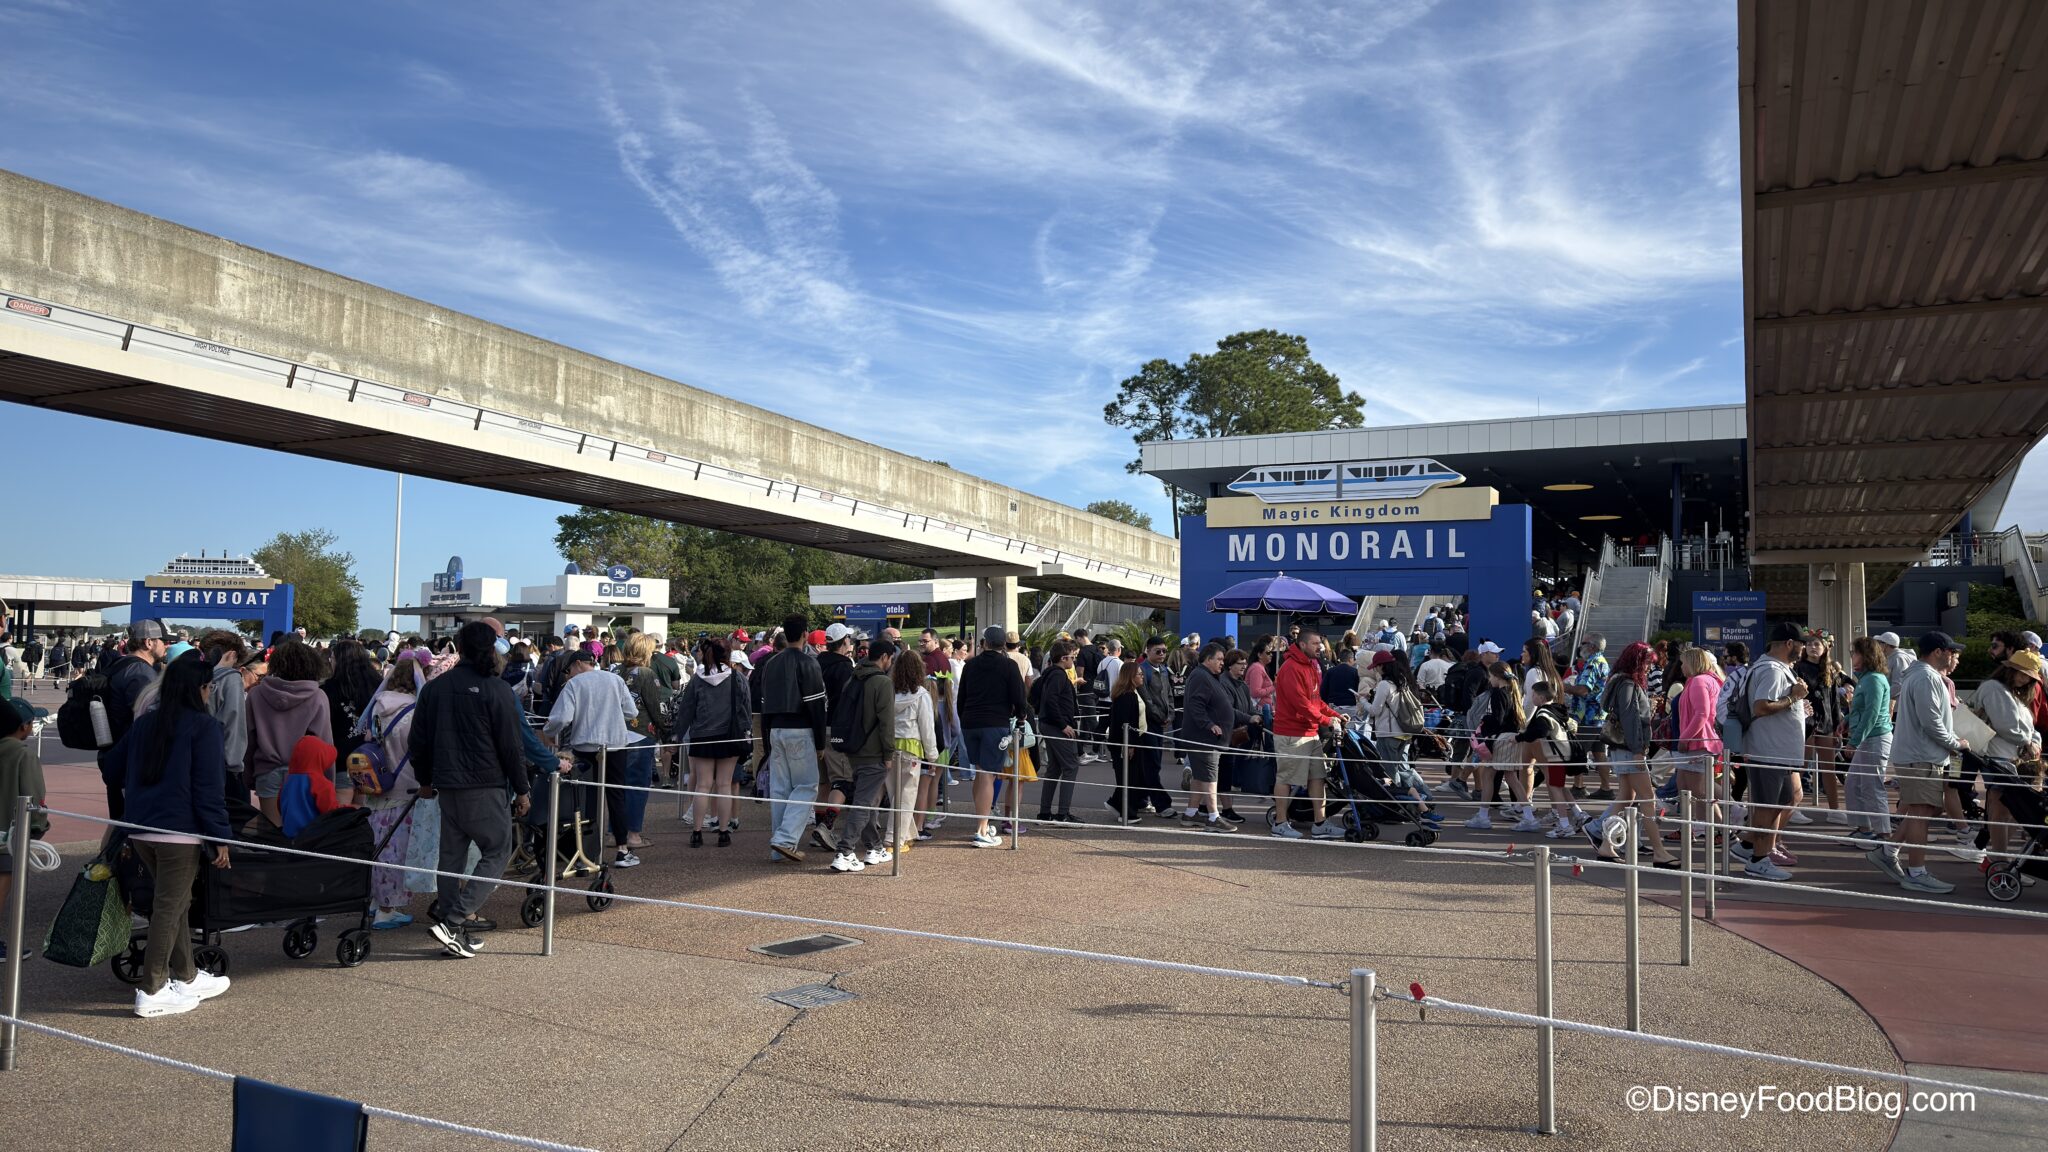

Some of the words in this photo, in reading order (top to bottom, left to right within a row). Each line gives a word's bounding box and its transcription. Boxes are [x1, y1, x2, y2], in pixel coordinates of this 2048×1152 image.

[13, 301, 45, 314] DANGER
[1262, 507, 1320, 521] Magic
[1330, 504, 1420, 519] Kingdom
[1228, 528, 1466, 562] MONORAIL
[173, 578, 201, 587] Magic
[205, 578, 246, 587] Kingdom
[150, 589, 270, 606] FERRYBOAT
[1700, 595, 1723, 603] Magic
[1724, 595, 1758, 603] Kingdom
[1722, 626, 1750, 634] Express
